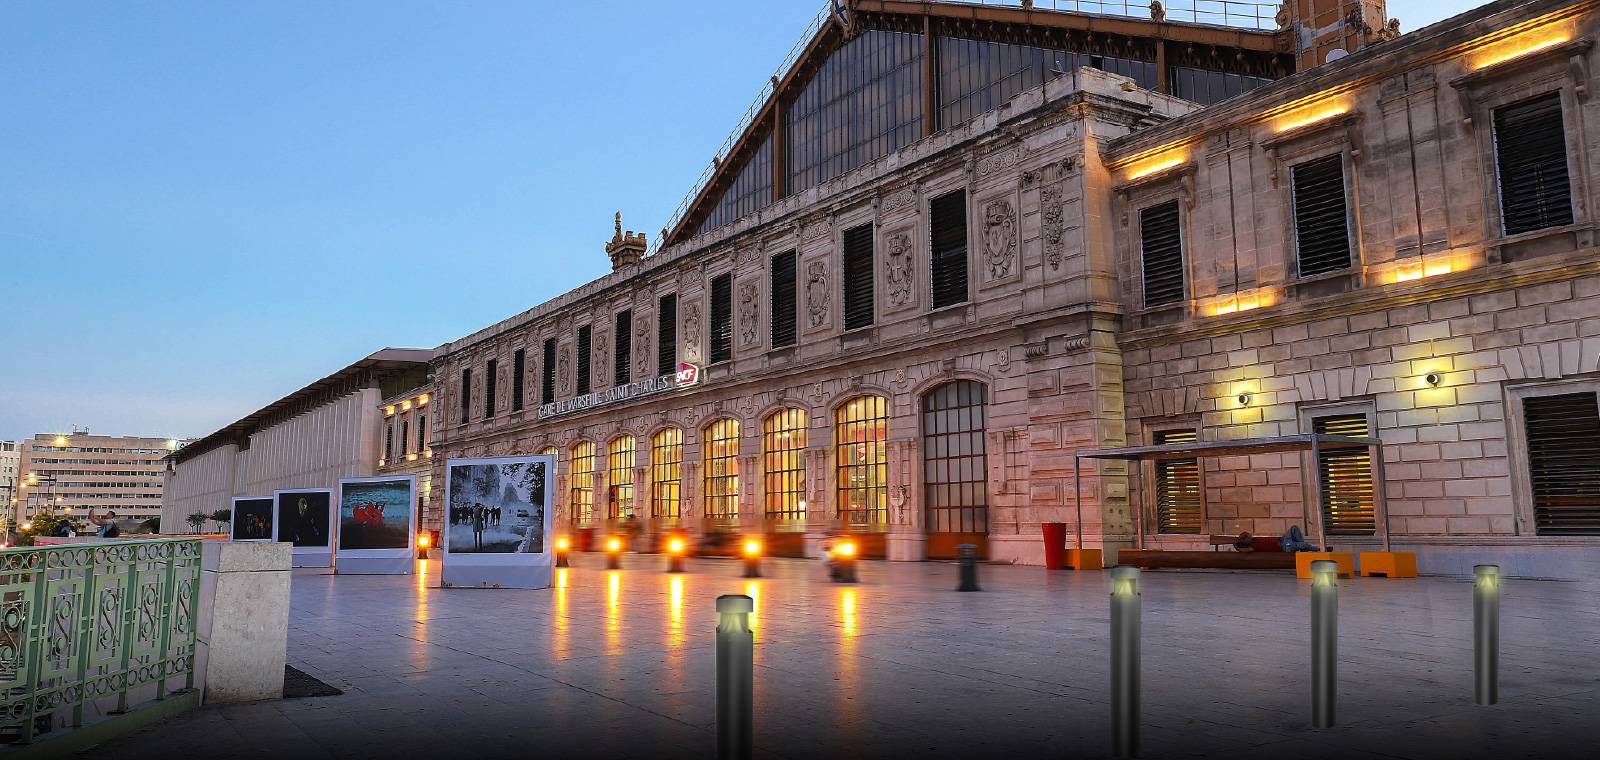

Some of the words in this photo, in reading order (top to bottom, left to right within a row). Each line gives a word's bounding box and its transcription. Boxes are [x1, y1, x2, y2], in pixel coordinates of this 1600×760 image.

[676, 368, 695, 383] SNCF
[539, 402, 556, 417] GARE
[556, 400, 565, 413] DE
[568, 391, 602, 411] MARSEILLE
[605, 384, 629, 401] SAINT
[631, 376, 668, 396] CHARLES
